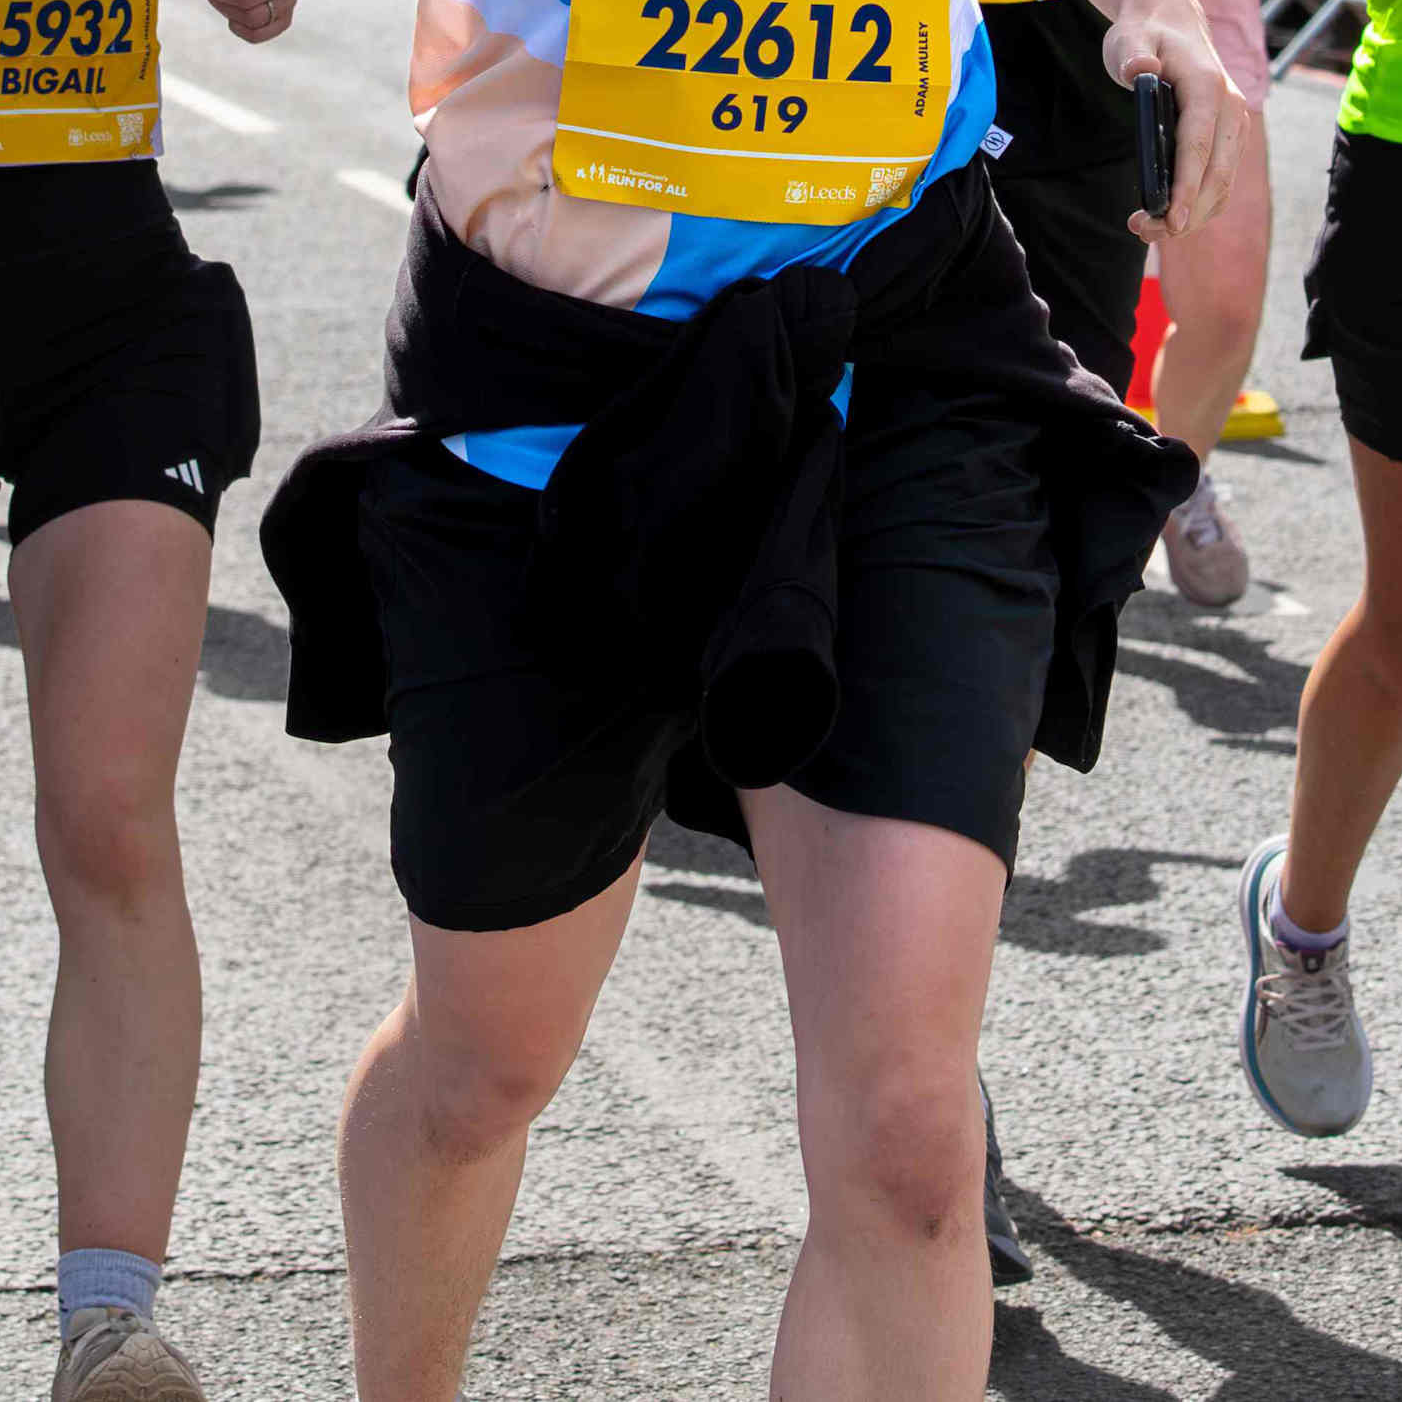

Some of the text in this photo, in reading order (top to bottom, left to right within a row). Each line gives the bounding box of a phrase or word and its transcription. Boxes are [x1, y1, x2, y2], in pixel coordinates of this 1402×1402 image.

[913, 21, 929, 117] ADAM MULLEY
[710, 92, 809, 134] 619
[607, 173, 689, 198] RUN FOR ALL
[809, 184, 857, 200] Leeds
